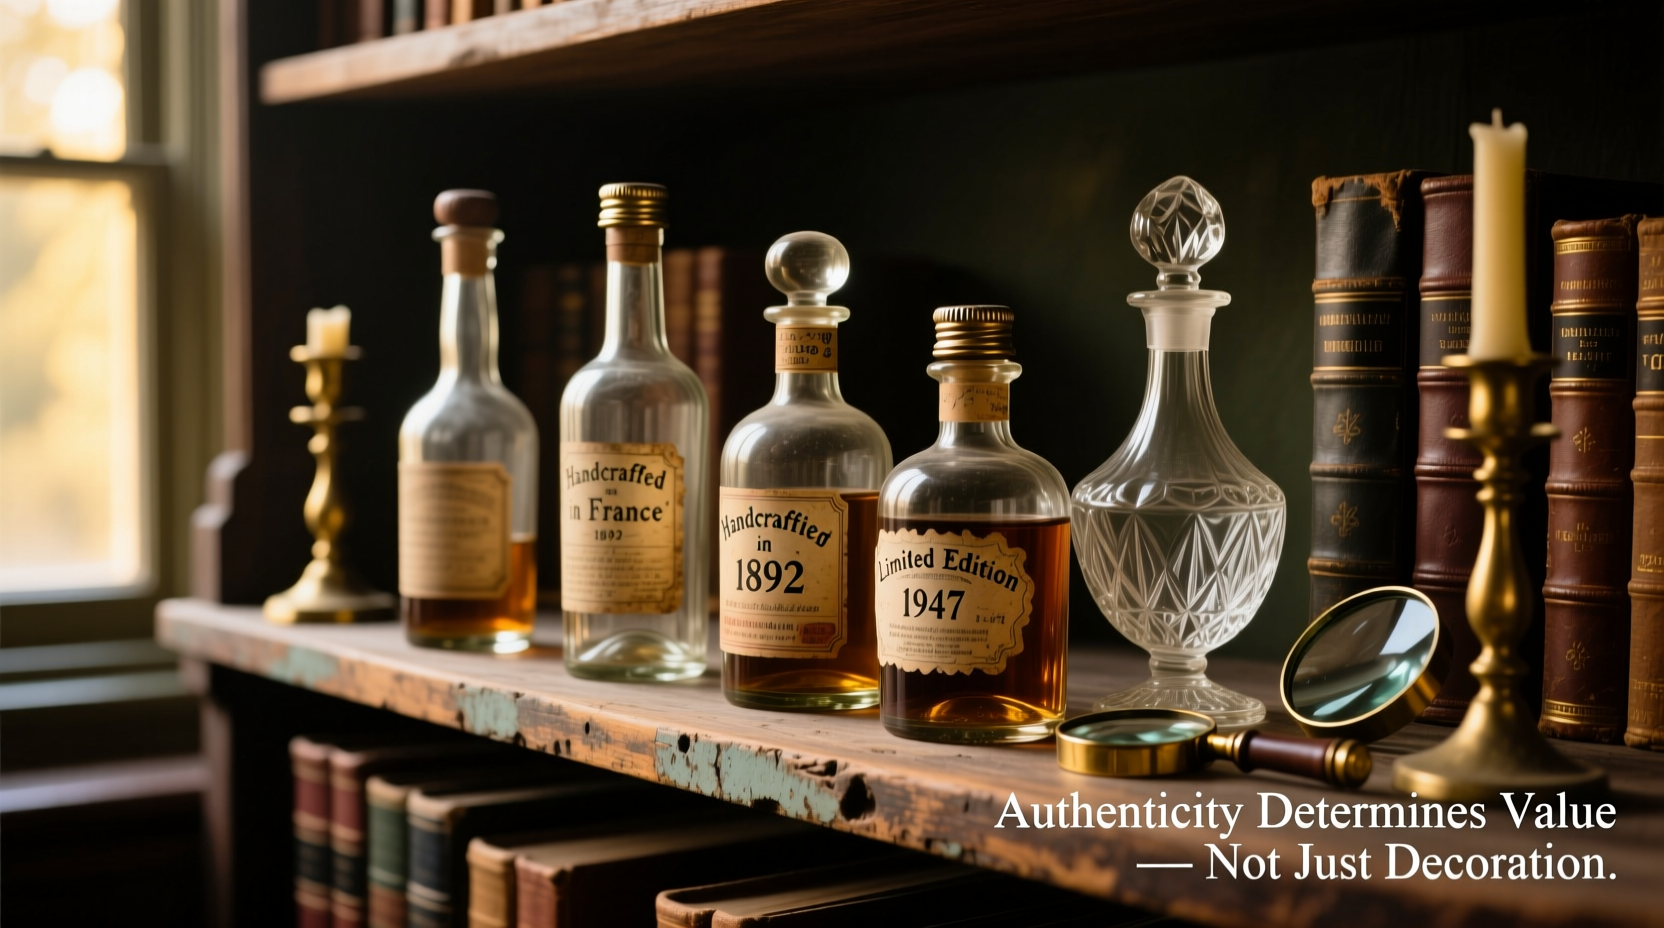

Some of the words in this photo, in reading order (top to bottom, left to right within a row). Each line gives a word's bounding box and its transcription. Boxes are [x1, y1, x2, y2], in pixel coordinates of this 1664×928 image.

[569, 499, 581, 520] in
[588, 497, 663, 522] France
[757, 535, 771, 552] in
[736, 558, 804, 594] 1892
[878, 547, 934, 582] Limited
[942, 548, 1019, 592] Edition
[903, 587, 965, 620] 1947
